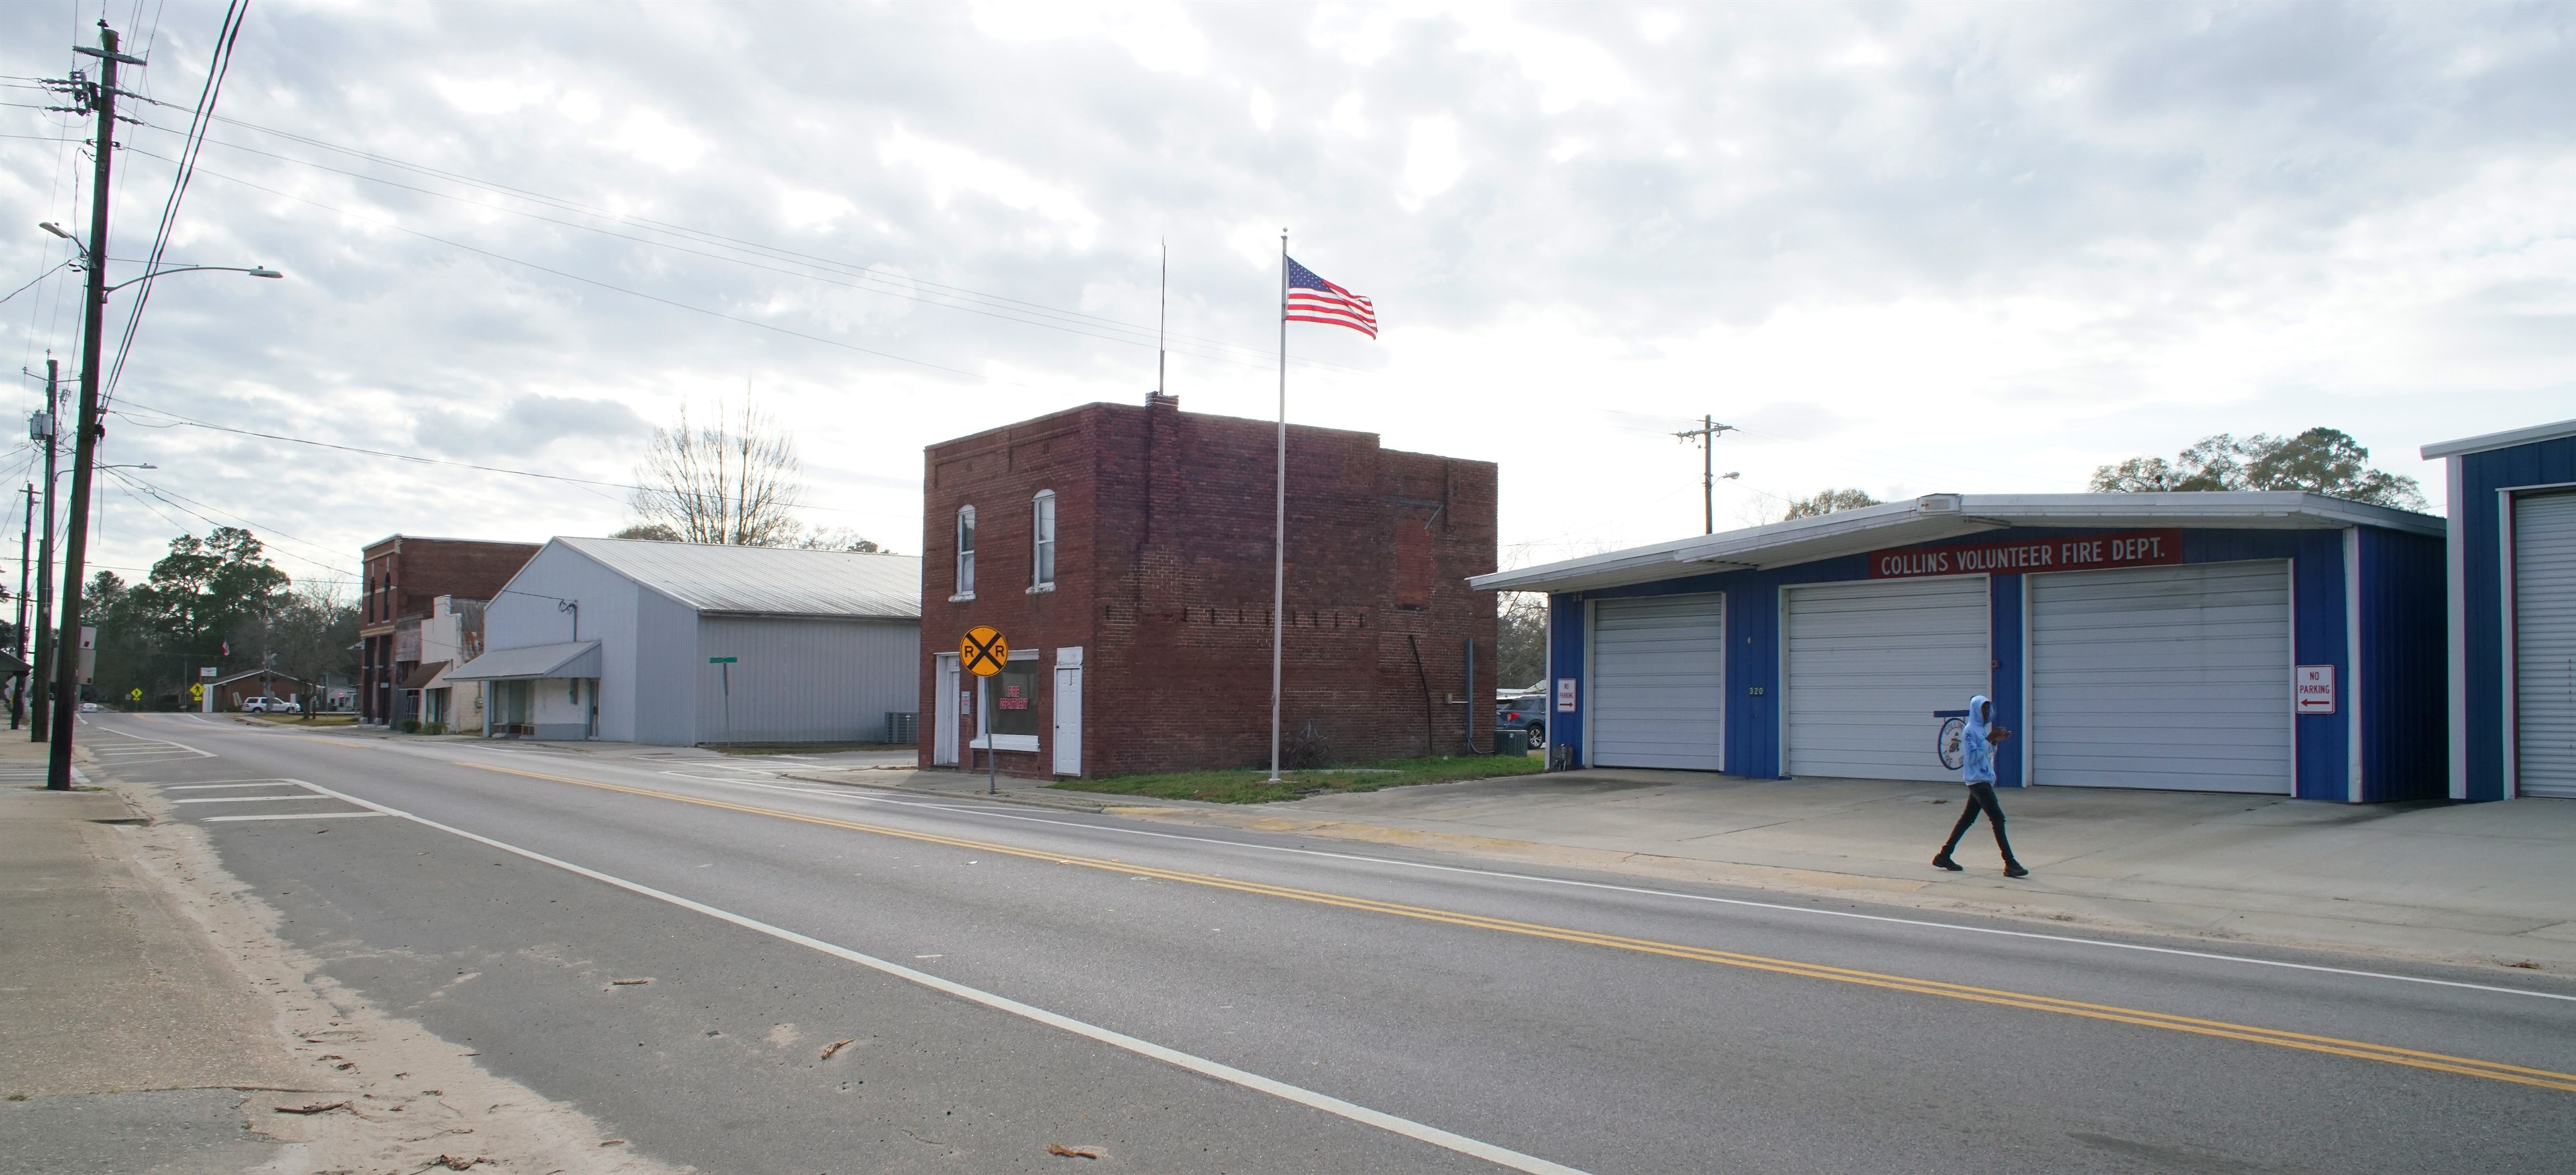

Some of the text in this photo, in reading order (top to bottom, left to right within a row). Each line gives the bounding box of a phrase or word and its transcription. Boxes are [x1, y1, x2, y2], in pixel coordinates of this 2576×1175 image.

[1881, 537, 2165, 576] COLLINS VOLUNTEER FIRE DEPT.
[2309, 671, 2320, 680] NO
[1008, 686, 1020, 697] FIRE
[1749, 687, 1764, 695] 320
[2300, 684, 2330, 694] PARKING
[1944, 720, 1965, 735] COLLIN
